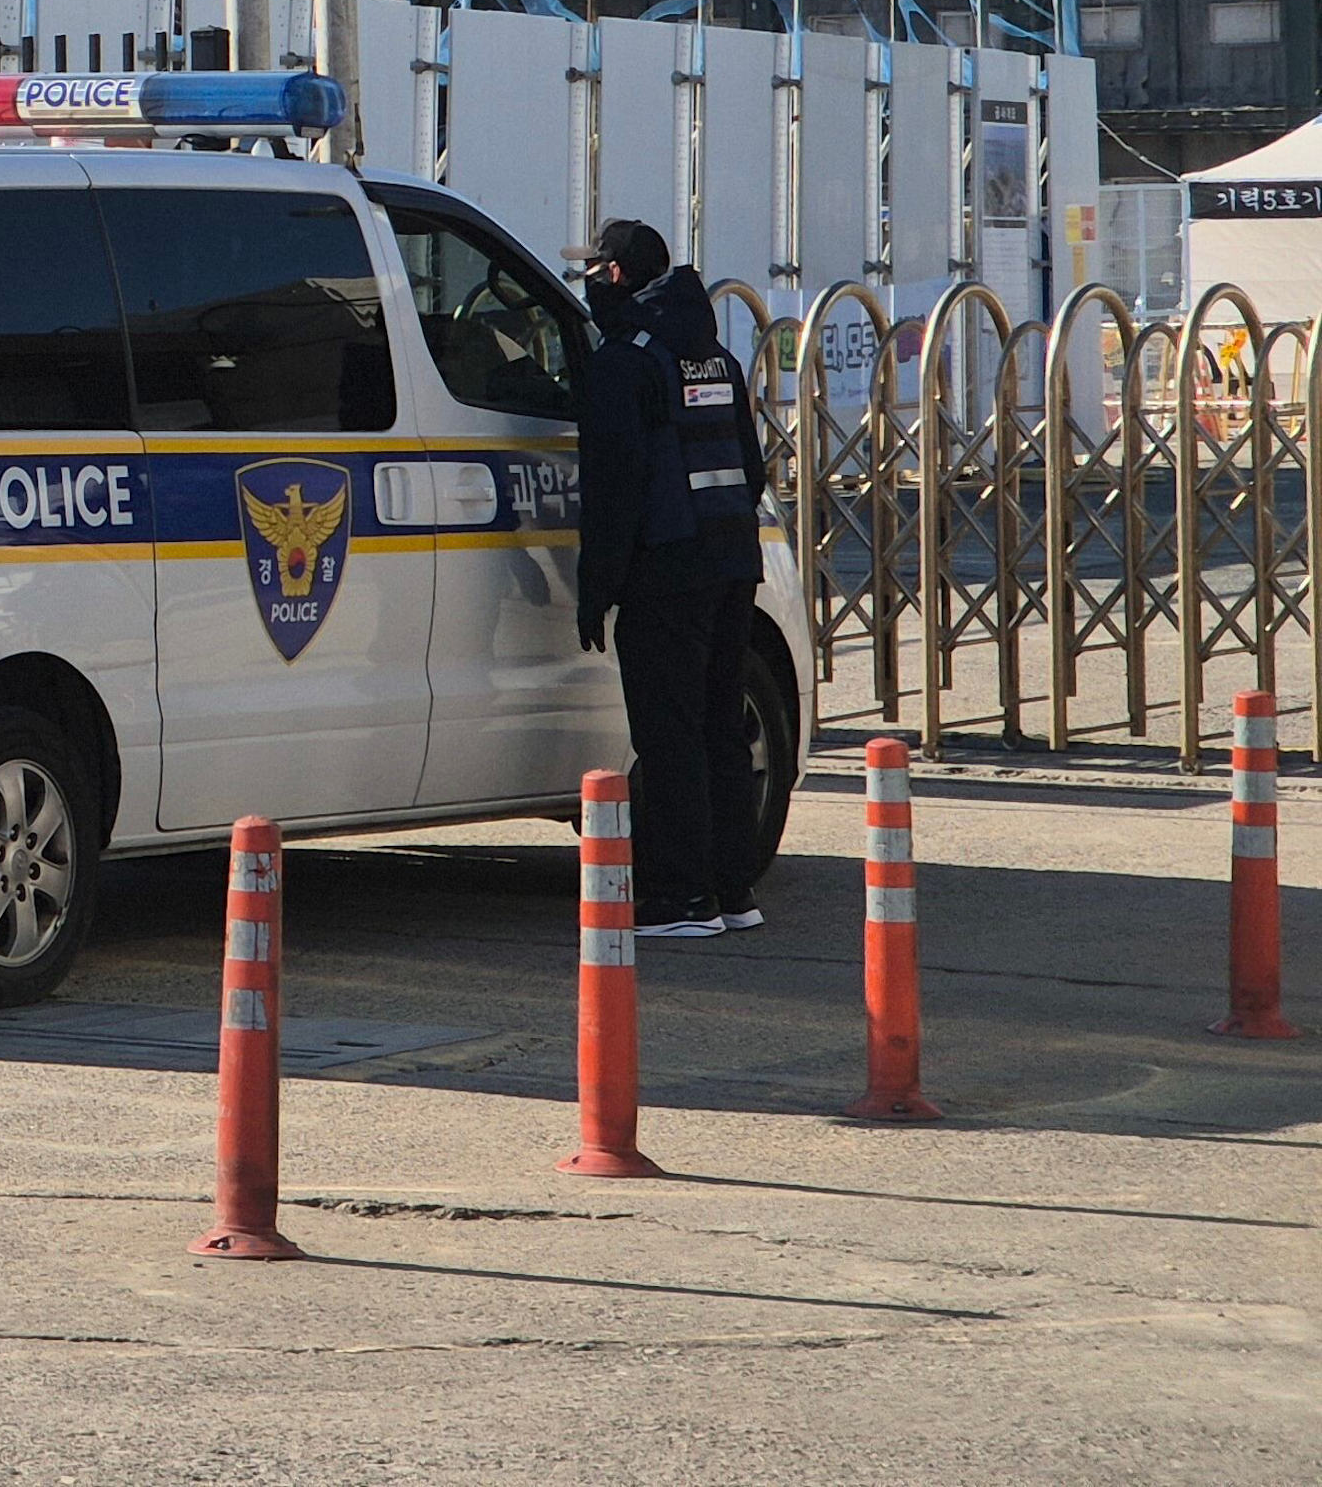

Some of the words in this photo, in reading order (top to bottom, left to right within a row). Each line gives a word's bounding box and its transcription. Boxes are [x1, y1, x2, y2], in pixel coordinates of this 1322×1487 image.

[25, 80, 130, 107] POLICE
[680, 357, 728, 380] SECURITY
[270, 602, 318, 623] POLICE
